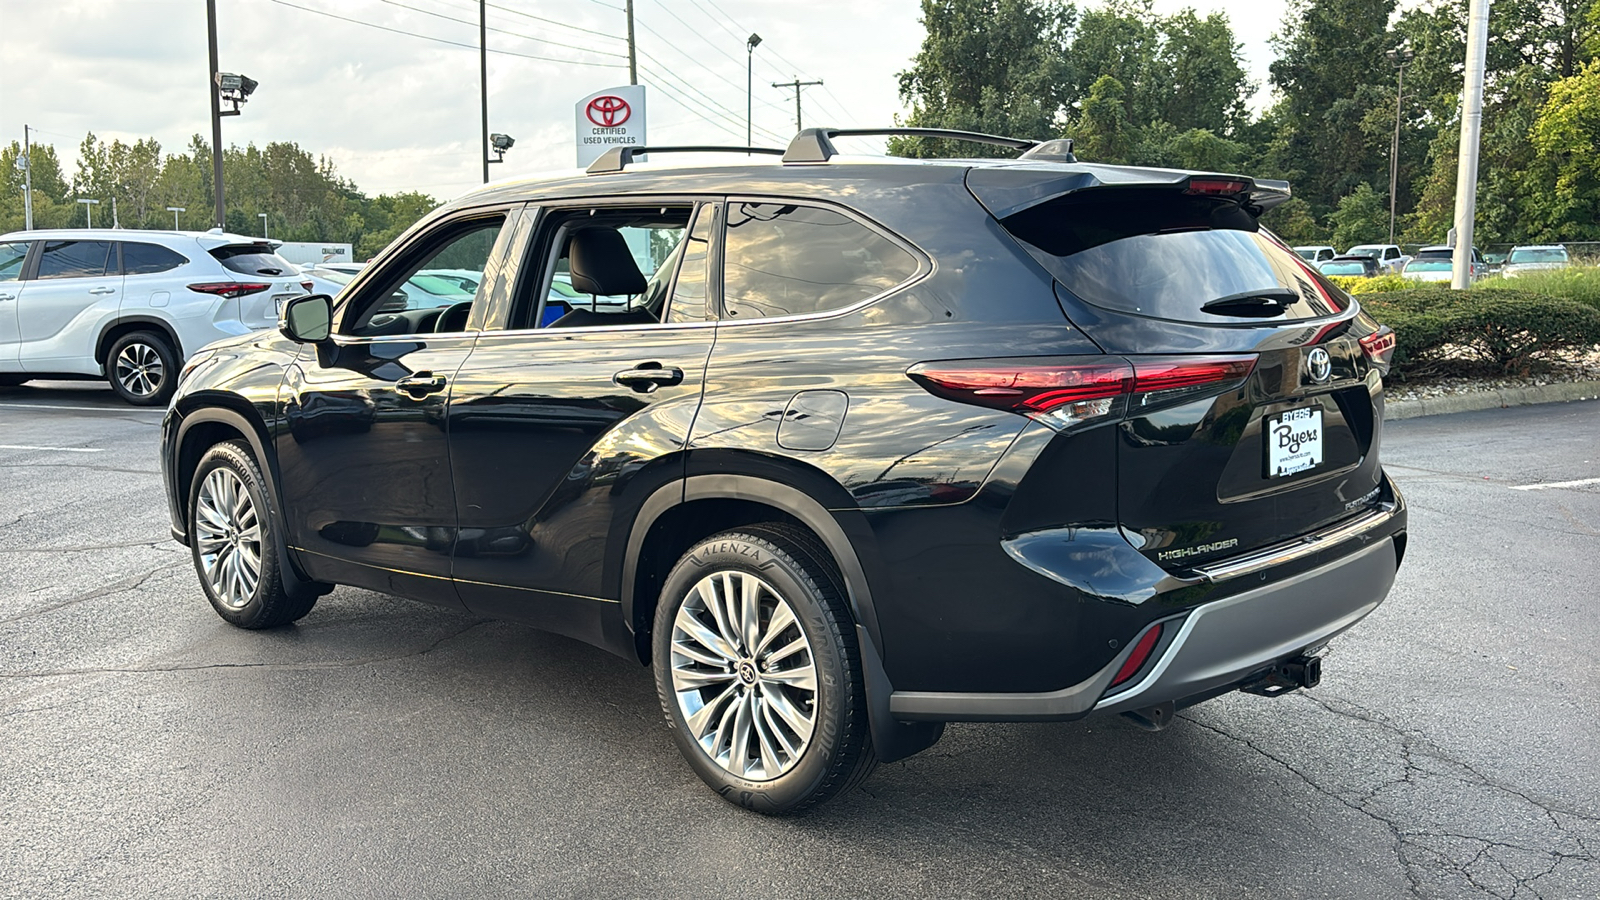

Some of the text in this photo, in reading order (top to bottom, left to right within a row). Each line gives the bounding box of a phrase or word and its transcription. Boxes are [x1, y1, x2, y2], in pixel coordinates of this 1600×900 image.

[592, 127, 626, 135] CERTIFIED
[583, 136, 636, 144] USED VEHICLES
[1282, 407, 1311, 422] BYERS
[1273, 425, 1317, 453] Byers
[702, 543, 760, 560] ALENZA
[1158, 538, 1238, 561] HIGHLANDER
[811, 616, 839, 761] BRIDGESTONE
